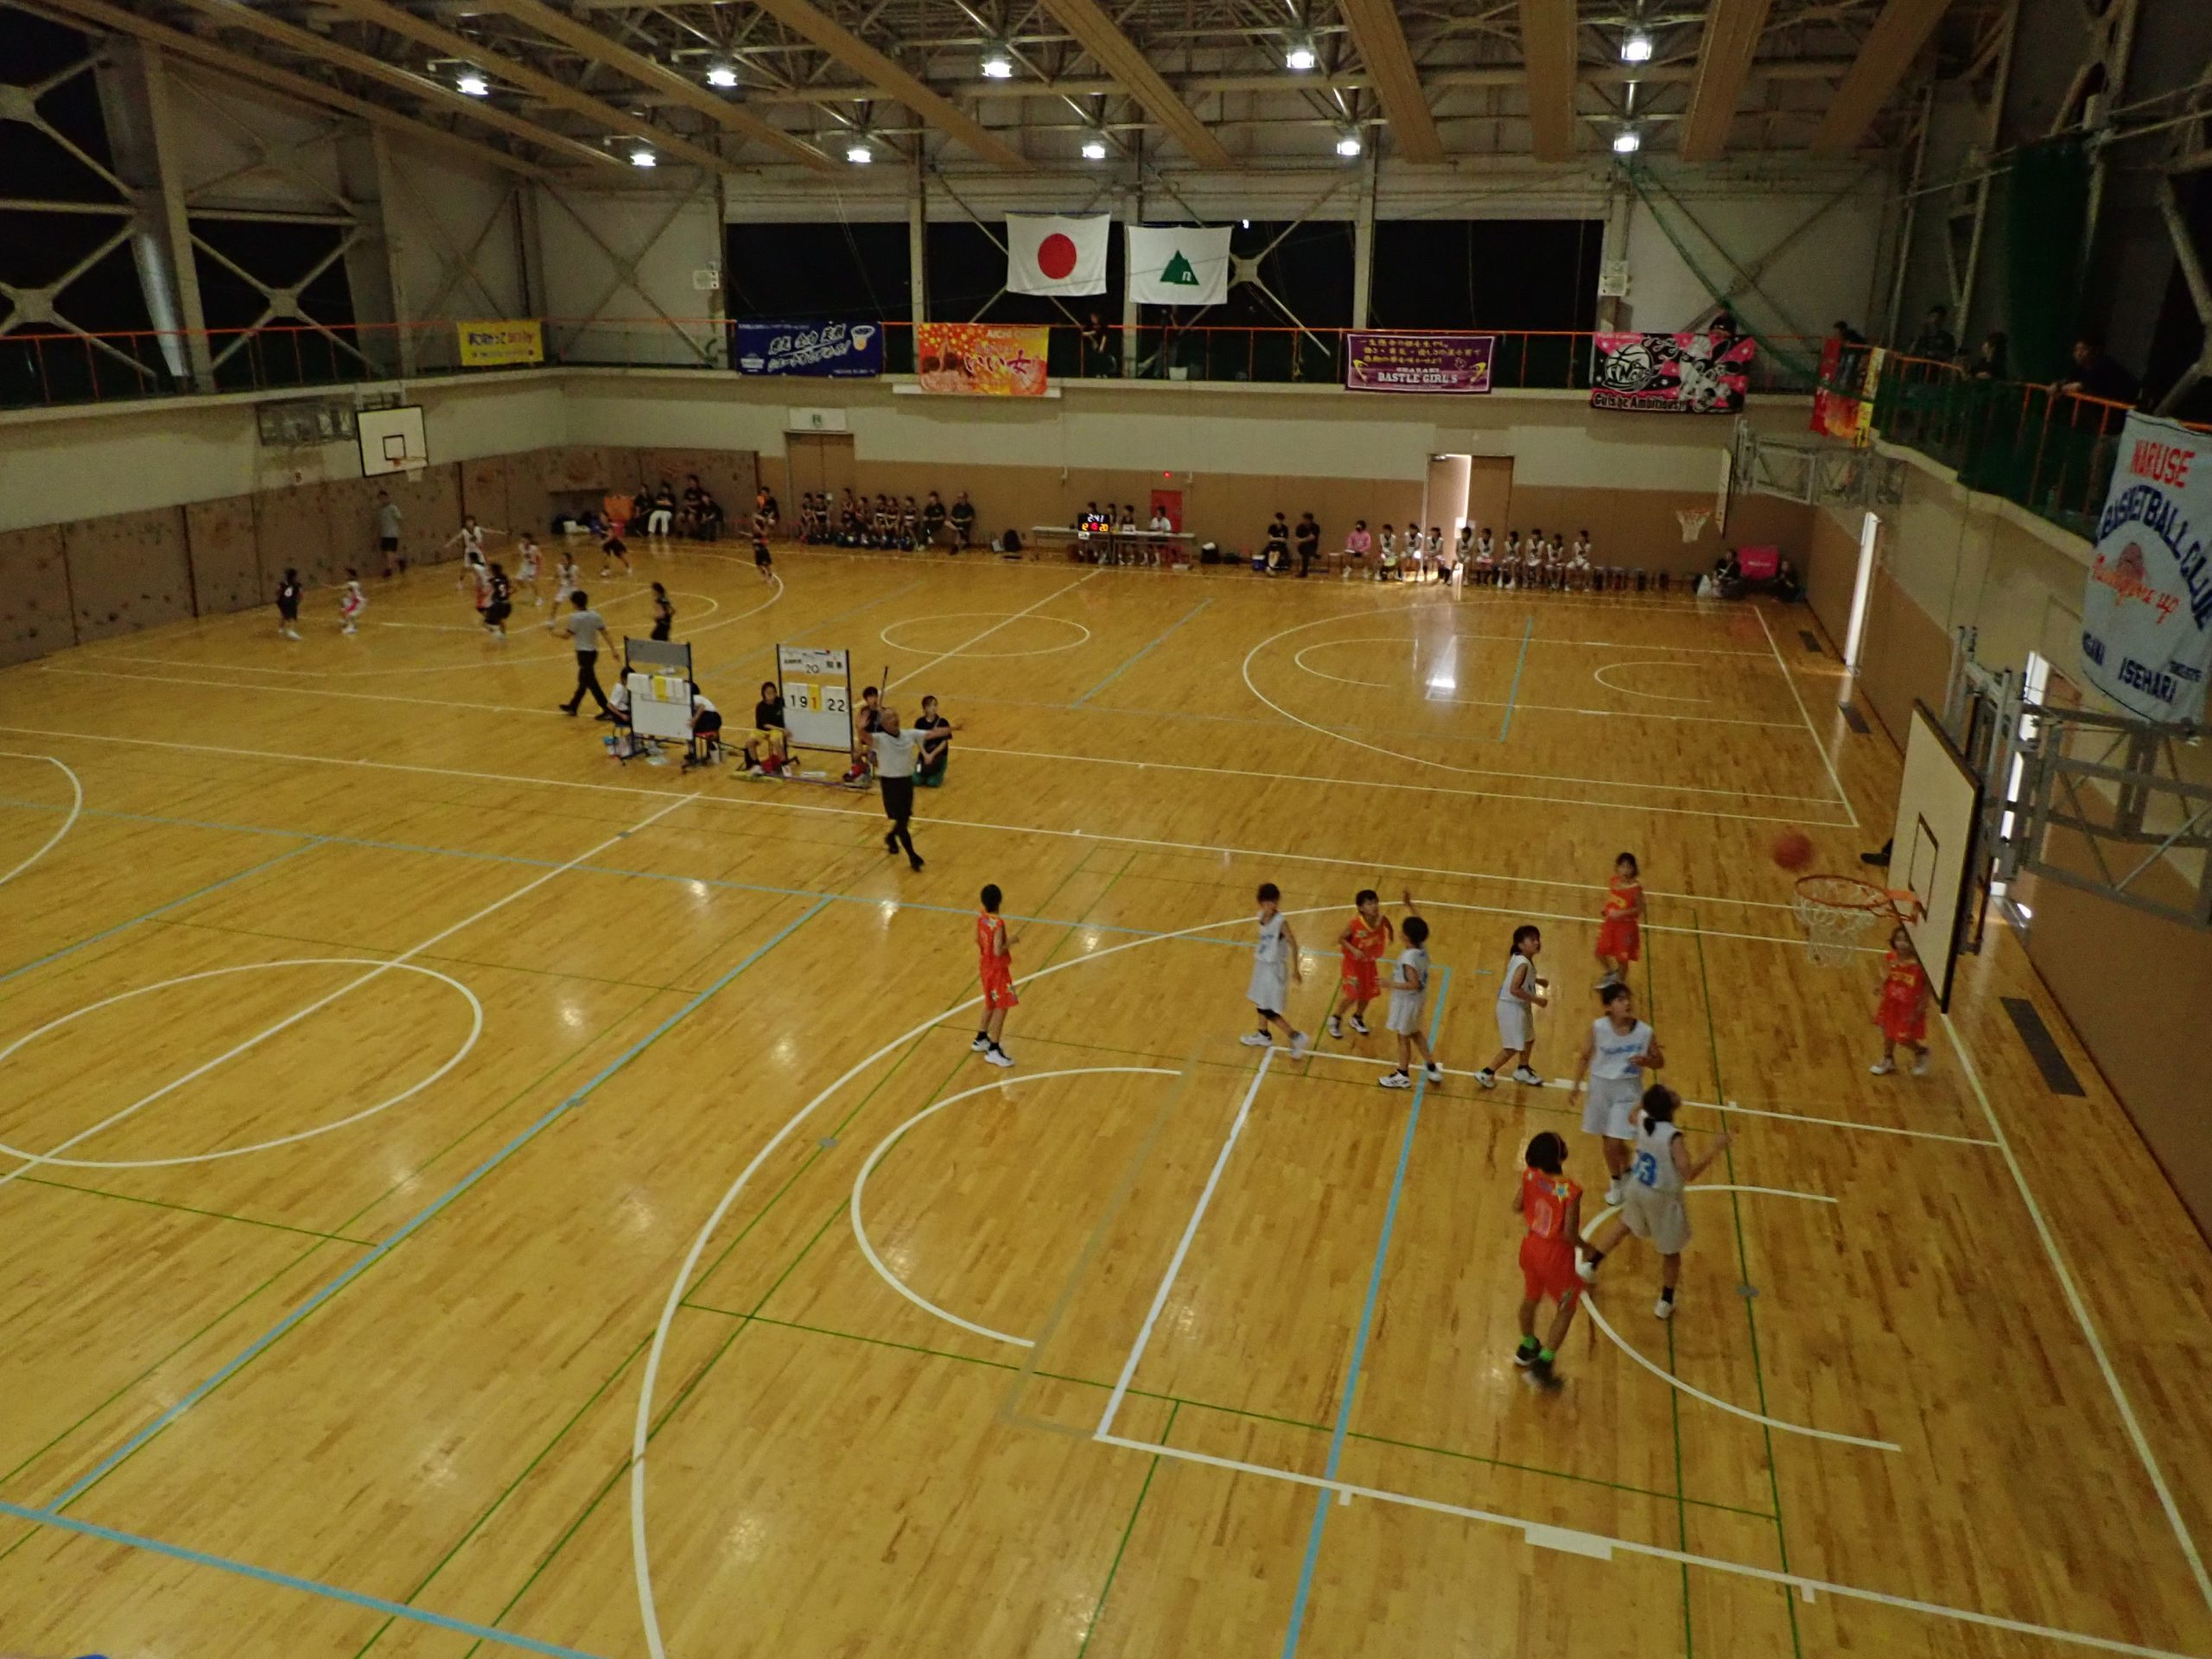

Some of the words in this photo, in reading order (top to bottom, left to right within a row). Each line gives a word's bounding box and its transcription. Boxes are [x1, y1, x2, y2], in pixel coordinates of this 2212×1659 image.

[791, 695, 808, 709] 19
[811, 696, 817, 710] 1
[828, 698, 845, 713] 22
